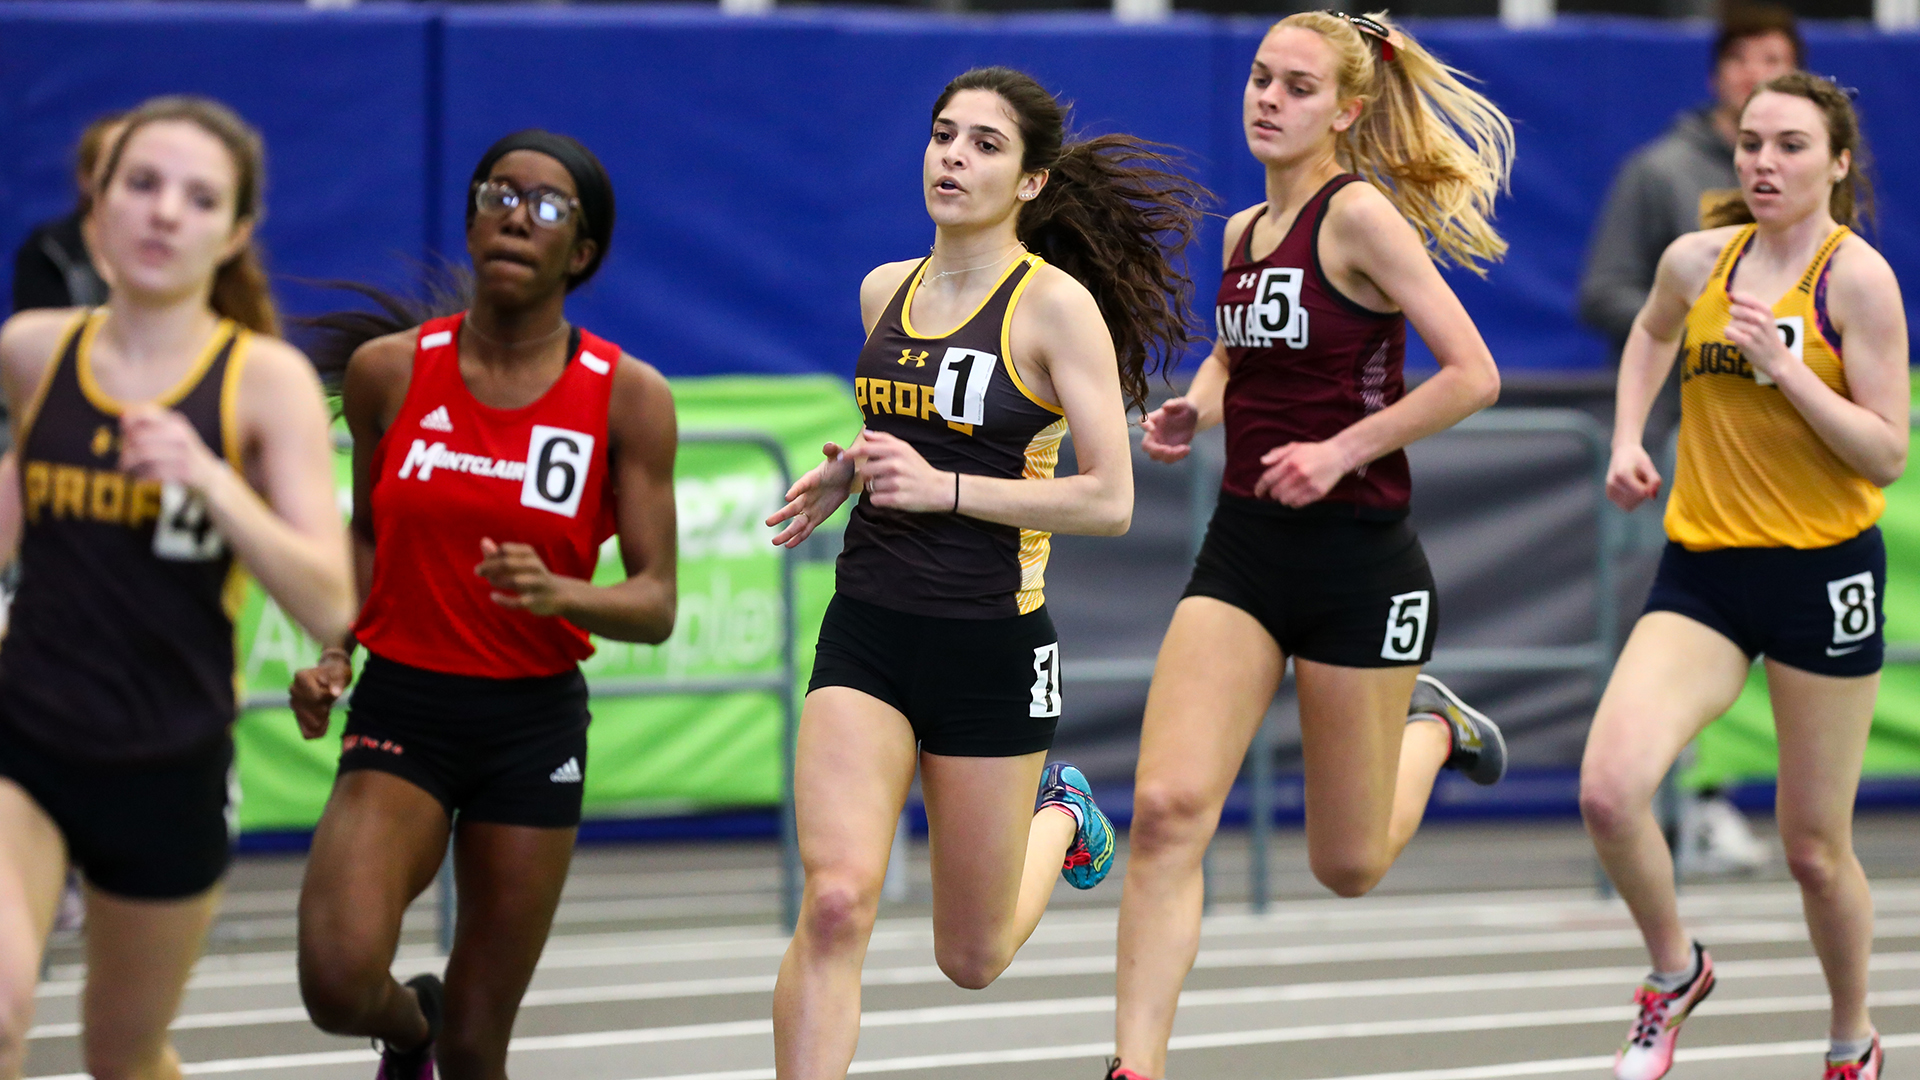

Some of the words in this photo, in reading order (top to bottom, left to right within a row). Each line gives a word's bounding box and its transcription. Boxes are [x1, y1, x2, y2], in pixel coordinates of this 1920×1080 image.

[1260, 274, 1291, 331] 5
[947, 354, 976, 418] 1
[25, 460, 163, 529] PROF
[536, 436, 579, 503] 6
[171, 486, 213, 546] 4
[1392, 598, 1422, 654] 5
[1839, 583, 1868, 635] 8
[1039, 650, 1054, 712] 1
